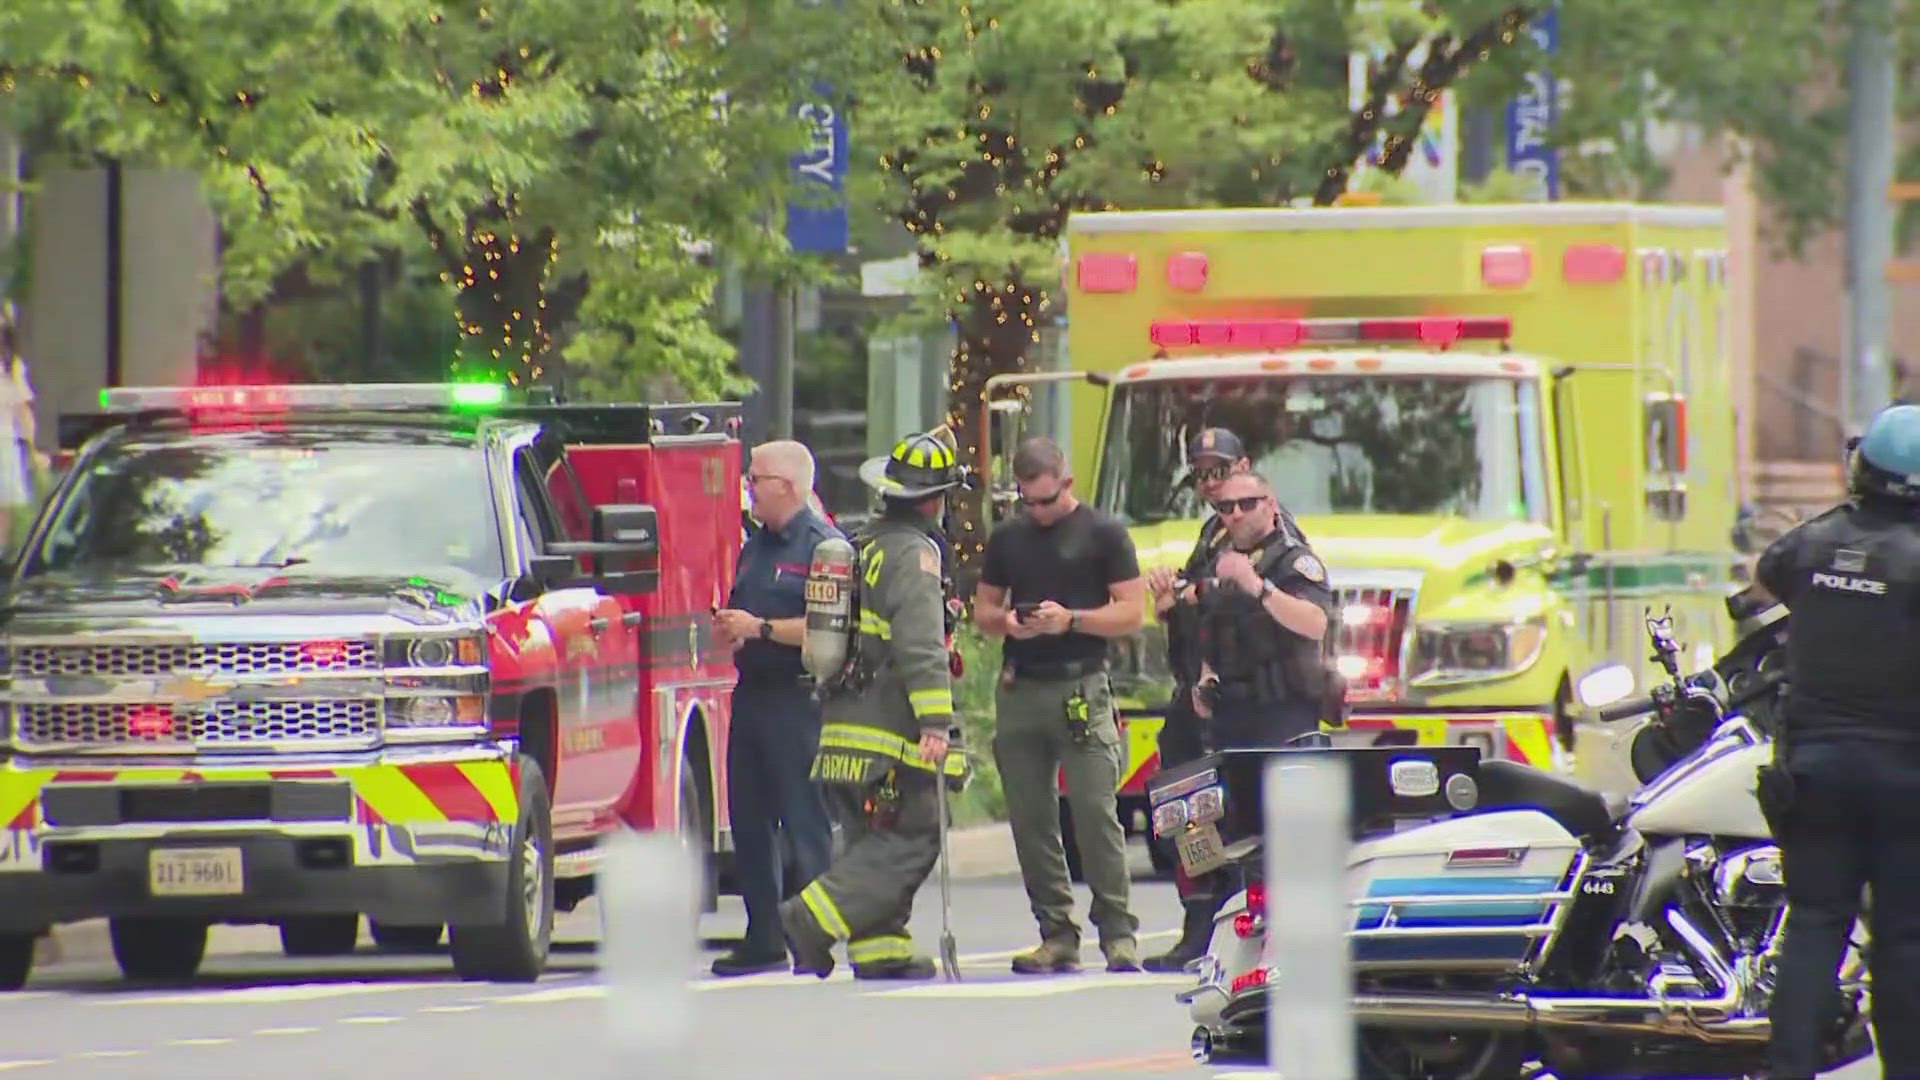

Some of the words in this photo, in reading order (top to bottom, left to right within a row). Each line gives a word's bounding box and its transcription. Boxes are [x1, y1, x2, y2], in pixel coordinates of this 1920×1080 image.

[799, 103, 834, 182] CITY
[1812, 573, 1888, 594] POLICE
[821, 752, 874, 783] BRYANT
[1583, 880, 1614, 896] 6443
